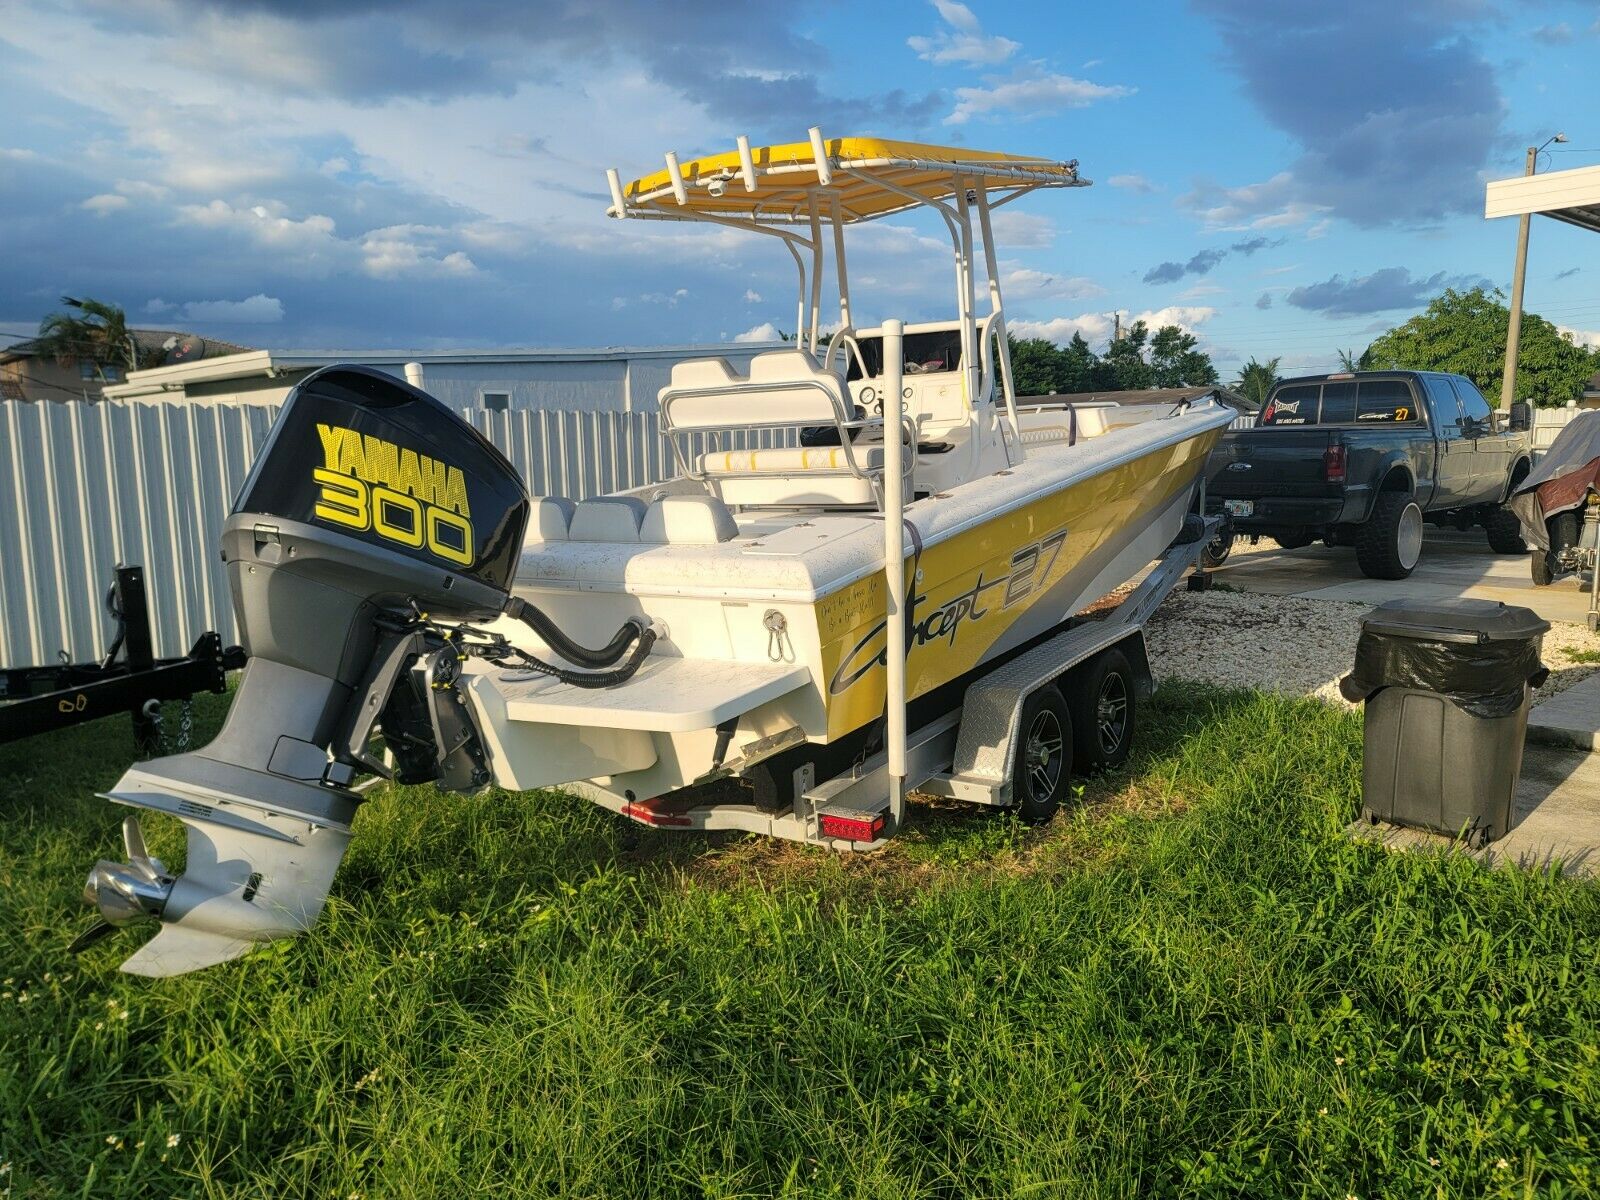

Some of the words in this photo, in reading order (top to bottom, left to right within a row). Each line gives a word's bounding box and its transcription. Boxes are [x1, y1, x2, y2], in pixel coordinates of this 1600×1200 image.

[1395, 408, 1409, 421] 27
[312, 467, 475, 568] 300
[316, 423, 471, 518] YAMAHA
[829, 571, 1010, 695] Cncept
[1003, 528, 1068, 610] 27
